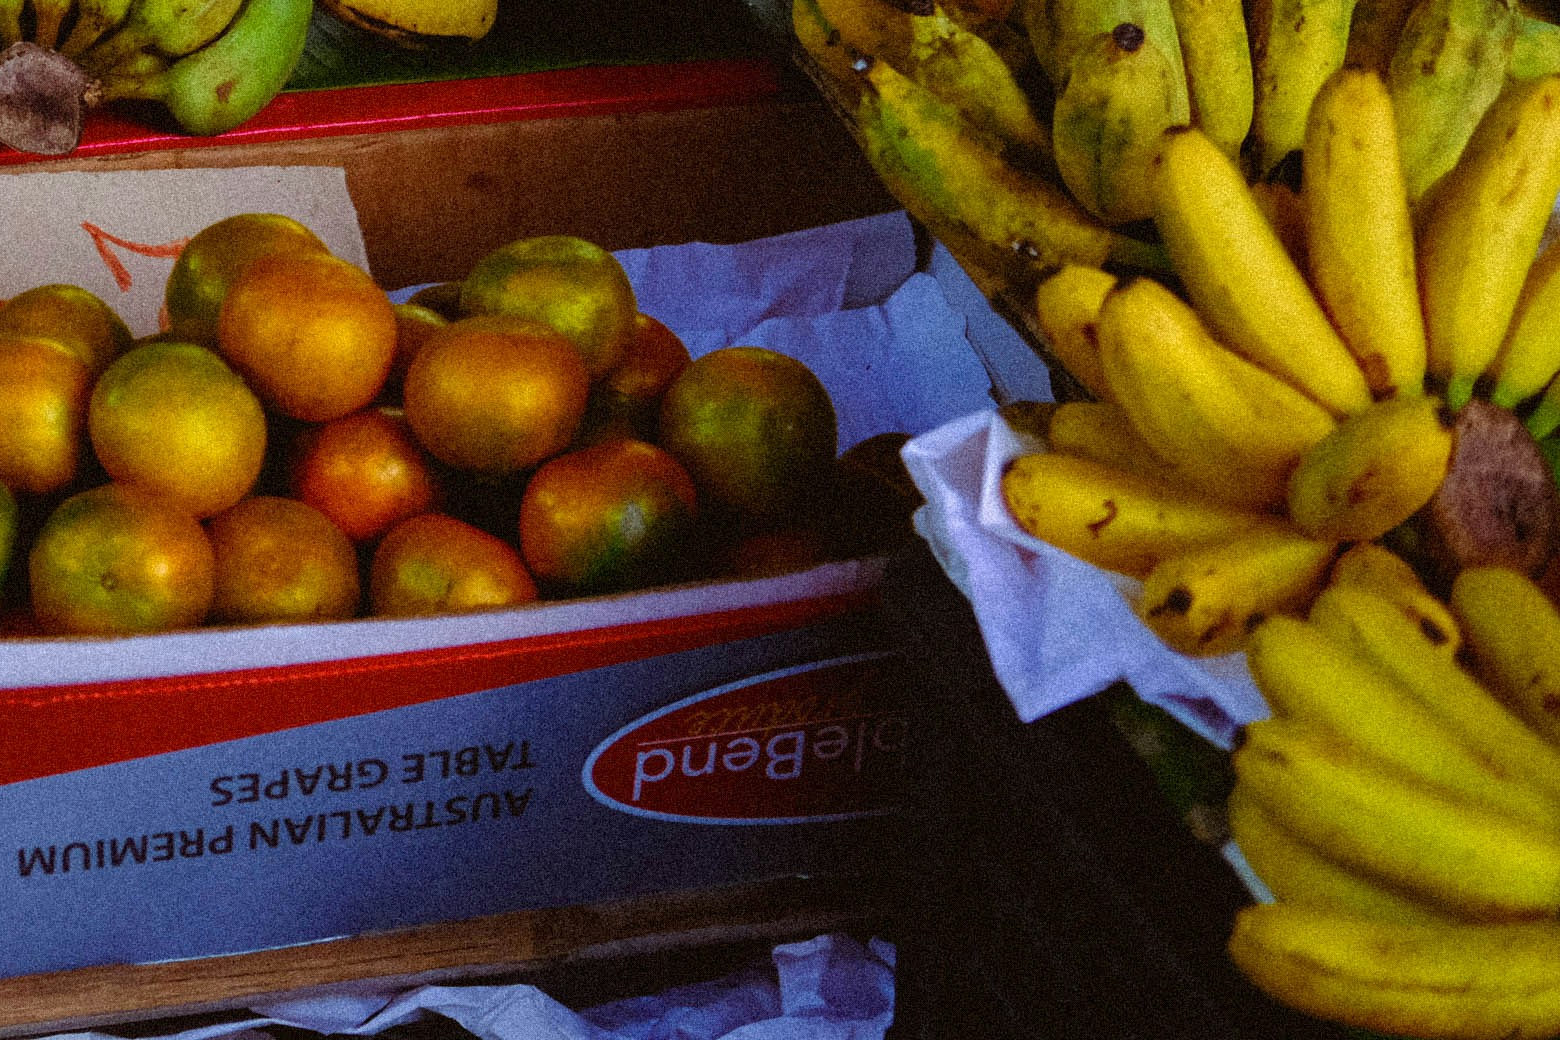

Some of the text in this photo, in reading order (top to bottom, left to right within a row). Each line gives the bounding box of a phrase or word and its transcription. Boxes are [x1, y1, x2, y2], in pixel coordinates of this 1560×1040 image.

[208, 739, 537, 807] TABLE GRAPES
[17, 786, 534, 878] AUSTRALIAN PREMIUM
